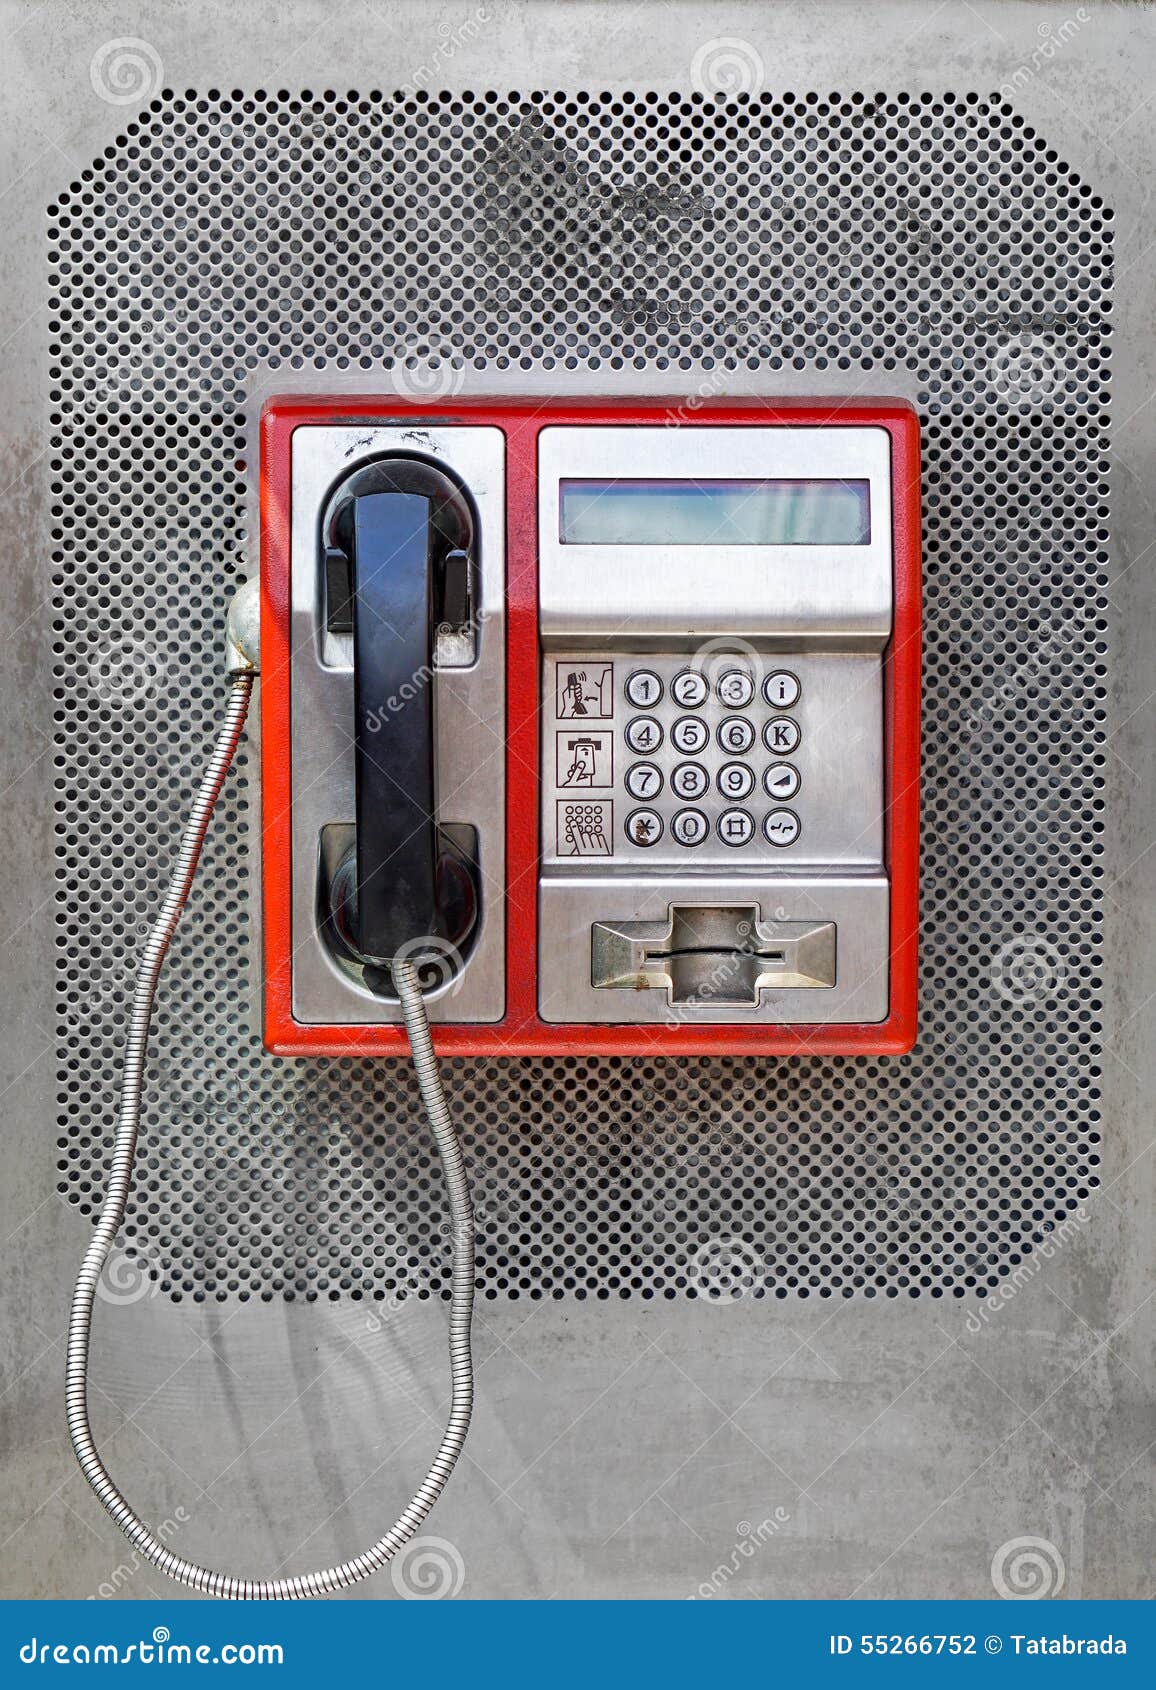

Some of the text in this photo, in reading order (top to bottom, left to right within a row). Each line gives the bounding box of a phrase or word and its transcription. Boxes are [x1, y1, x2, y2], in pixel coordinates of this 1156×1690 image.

[640, 679, 786, 700] 1 2 3 i
[636, 725, 790, 746] 4 5 6 K
[637, 771, 744, 792] 7 8 9
[682, 817, 698, 838] 0
